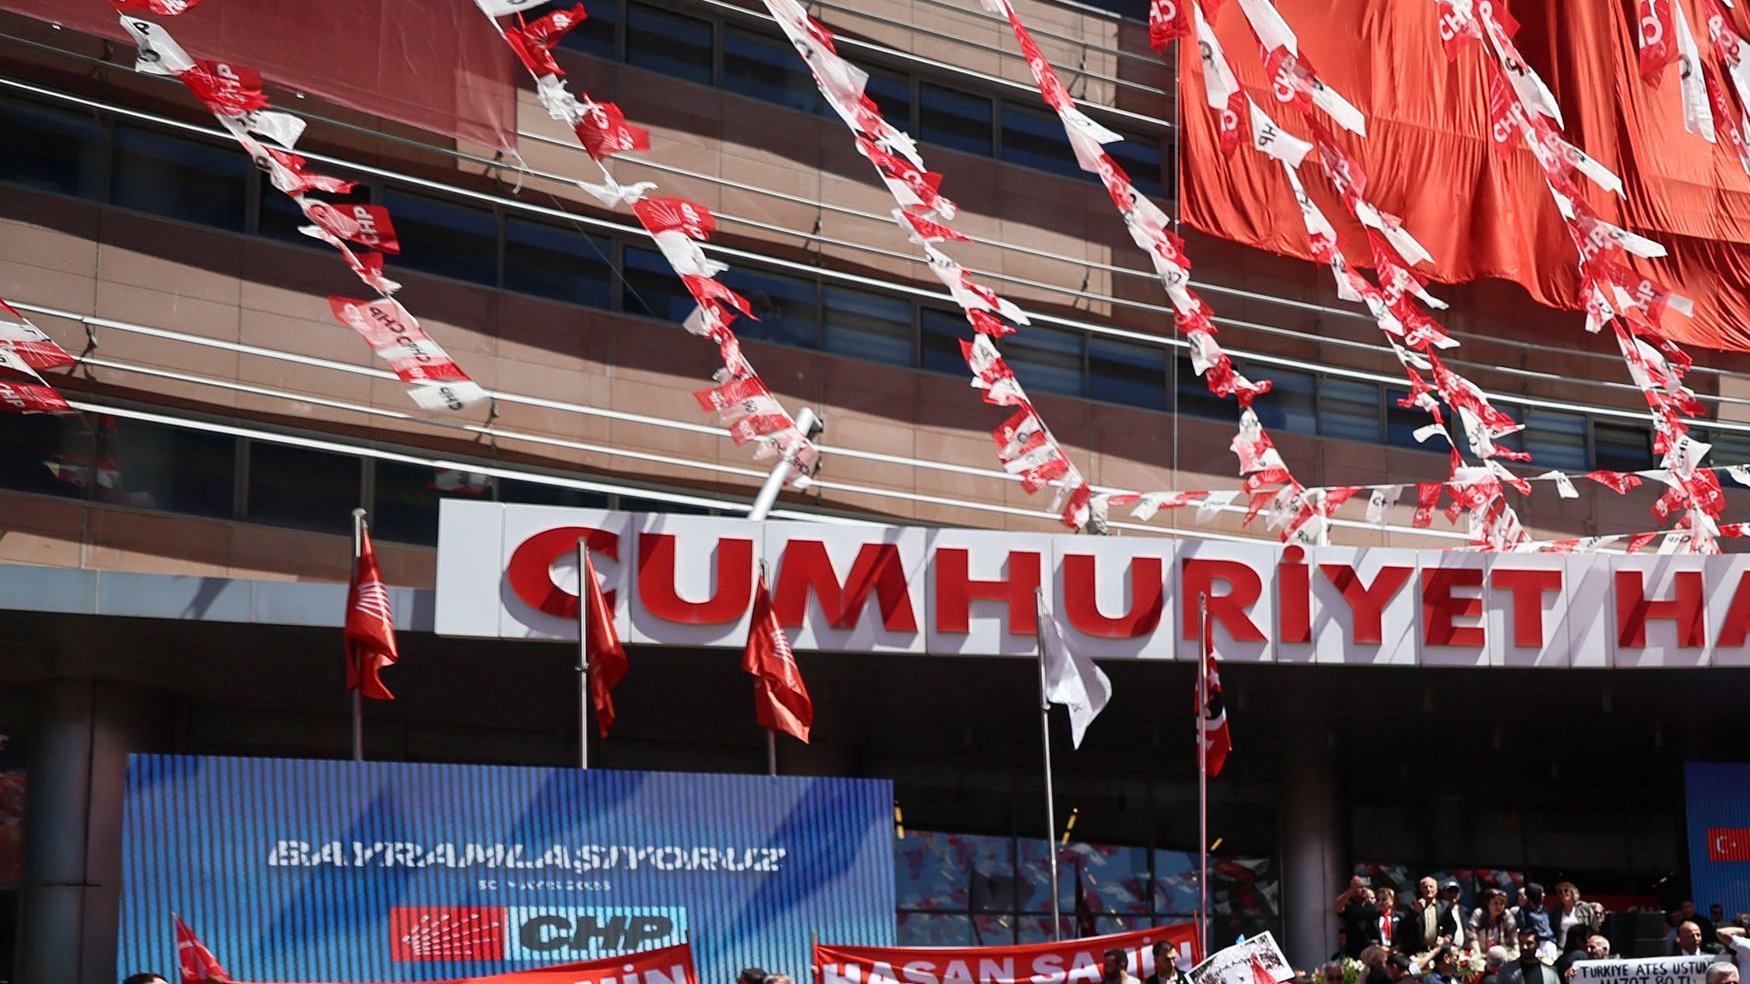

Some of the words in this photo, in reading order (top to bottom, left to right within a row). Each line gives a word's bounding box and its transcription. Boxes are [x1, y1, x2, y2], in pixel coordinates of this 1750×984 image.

[1493, 101, 1523, 143] CHP
[507, 526, 1565, 649] CUMHURİYET
[520, 914, 673, 952] CHP
